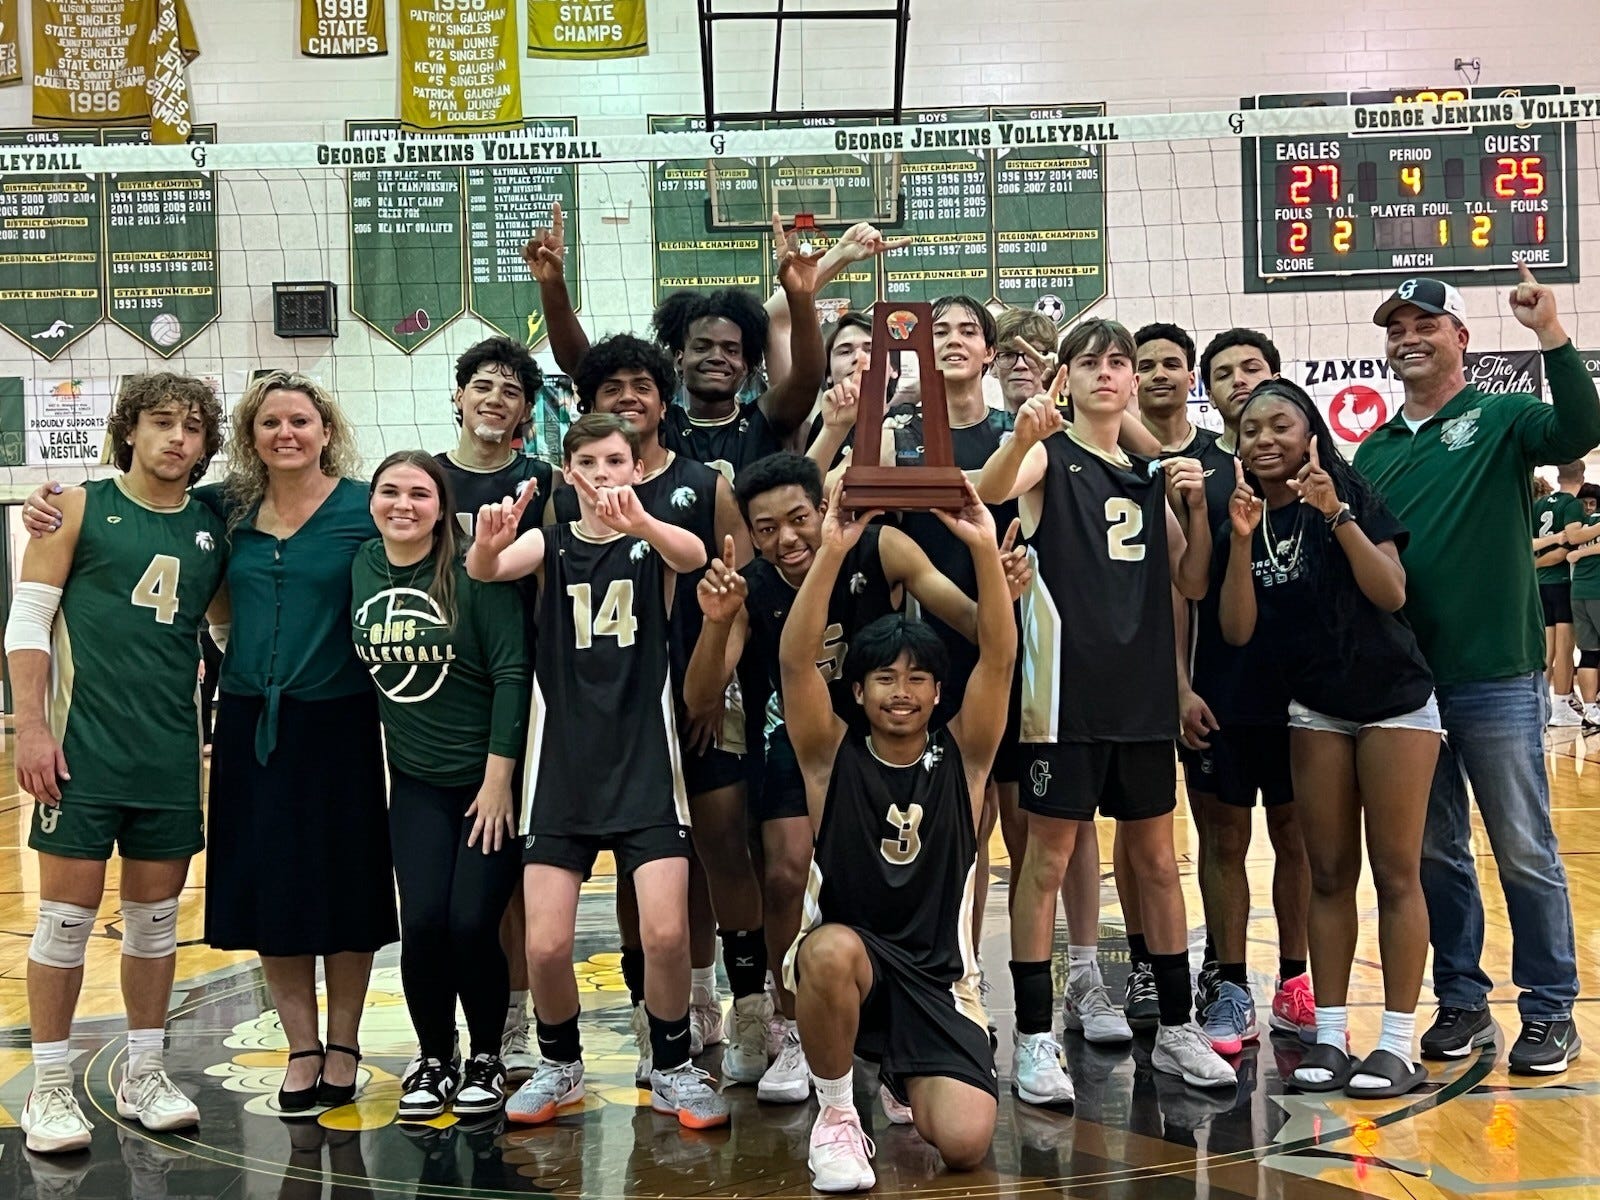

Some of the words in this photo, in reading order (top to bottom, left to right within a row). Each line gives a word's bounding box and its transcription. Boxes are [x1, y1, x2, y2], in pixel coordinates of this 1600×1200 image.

[59, 4, 86, 13] ALISON
[560, 4, 615, 22] STATE
[76, 14, 121, 26] SINGLES
[410, 9, 453, 23] PATRICK
[460, 8, 506, 23] GAUGHAN
[44, 24, 77, 37] STATE
[81, 24, 137, 38] RUNNER-UP
[318, 20, 367, 36] STATE
[429, 24, 441, 35] #1
[446, 23, 491, 36] SINGLES
[554, 25, 623, 42] CHAMPS
[57, 38, 92, 47] JENNIFER
[95, 37, 129, 47] SINCLAIR
[308, 37, 379, 54] CHAMPS
[427, 37, 454, 49] RYAN
[463, 36, 500, 49] DUNNE
[80, 47, 125, 59] SINGLES
[428, 50, 444, 60] #2
[449, 49, 494, 61] SINGLES
[58, 58, 90, 71] STATE
[414, 62, 446, 74] KEVIN
[458, 59, 506, 75] GAUGHAN
[34, 75, 80, 90] DOUBLES
[83, 80, 112, 91] STATE
[114, 75, 146, 88] CHAMP
[428, 75, 443, 86] #5
[449, 74, 495, 87] SINGLES
[413, 86, 455, 99] PATRICK
[463, 84, 511, 99] GAUGHAN
[69, 91, 120, 113] 1996
[428, 100, 457, 110] RYAN
[467, 98, 502, 110] DUNNE
[430, 111, 441, 121] #1
[447, 110, 496, 121] DOUBLES
[918, 113, 947, 123] BOYS
[1030, 110, 1062, 119] GIRLS
[1355, 107, 1424, 129] GEORGE
[1432, 104, 1513, 125] JENKINS
[26, 133, 59, 142] GIRLS
[835, 130, 903, 151] GEORGE
[911, 127, 991, 148] JENKINS
[998, 122, 1119, 145] VOLLEYBALL
[1276, 141, 1340, 161] EAGLES
[1484, 135, 1541, 154] GUEST
[317, 144, 386, 165] GEORGE
[394, 142, 475, 163] JENKINS
[482, 140, 602, 160] VOLLEYBALL
[1389, 148, 1431, 162] PERIOD
[930, 163, 974, 171] CHAMPIONS
[848, 177, 870, 187] 2001
[910, 175, 933, 185] 1995
[937, 174, 959, 184] 1996
[963, 172, 985, 183] 1997
[1023, 171, 1045, 181] 1997
[1400, 167, 1421, 195] 4
[1495, 157, 1544, 198] 25
[657, 181, 679, 191] 1997
[683, 180, 705, 190] 1998
[735, 180, 758, 190] 2000
[911, 187, 934, 197] 1999
[963, 184, 985, 194] 2001
[1023, 182, 1046, 193] 2007
[1049, 182, 1072, 192] 2011
[1290, 165, 1338, 204] 27
[21, 194, 44, 204] 2000
[47, 193, 69, 203] 2003
[110, 192, 133, 203] 1994
[136, 191, 159, 202] 1995
[162, 191, 185, 201] 1996
[911, 198, 934, 208] 2003
[963, 196, 986, 206] 2005
[21, 205, 45, 215] 2007
[163, 202, 186, 212] 2009
[188, 201, 211, 212] 2011
[1371, 204, 1415, 217] PLAYER
[1422, 203, 1452, 215] FOUL
[1464, 201, 1497, 215] T.O.L.
[1510, 199, 1549, 213] FOULS
[911, 210, 934, 220] 2010
[938, 208, 960, 219] 2012
[963, 207, 986, 217] 2017
[1275, 207, 1313, 220] FOULS
[111, 216, 134, 226] 2012
[22, 229, 45, 239] 2010
[1000, 232, 1043, 240] REGIONAL
[1333, 220, 1353, 252] 2
[1438, 219, 1448, 246] 1
[1471, 216, 1491, 248] 2
[1536, 215, 1545, 244] 1
[933, 234, 984, 242] CHAMPIONS
[1289, 222, 1308, 253] 2
[912, 246, 935, 256] 1995
[939, 245, 961, 255] 1997
[964, 244, 987, 254] 2005
[998, 243, 1020, 252] 2005
[1024, 242, 1047, 252] 2010
[45, 254, 94, 262] CHAMPIONS
[1392, 253, 1433, 267] MATCH
[1511, 249, 1550, 263] SCORE
[139, 262, 162, 272] 1995
[1276, 258, 1314, 271] SCORE
[890, 272, 922, 280] STATE
[924, 270, 984, 278] RUNNER-UP
[1001, 268, 1032, 276] STATE
[1036, 267, 1096, 275] RUNNER-UP
[888, 282, 910, 293] 2005
[1051, 277, 1073, 287] 2013
[2, 291, 33, 299] STATE
[36, 290, 95, 298] RUNNER-UP
[151, 287, 210, 295] RUNNER-UP
[114, 299, 137, 309] 1993
[141, 298, 163, 308] 1995
[1479, 355, 1514, 379] The
[31, 418, 64, 428] PROUDLY
[67, 418, 105, 427] SUPPORTS
[50, 431, 88, 445] EAGLES
[39, 445, 98, 459] WRESTLING
[1104, 497, 1146, 562] 2
[1539, 510, 1554, 538] 2
[131, 554, 180, 625] 4
[566, 579, 638, 649] 14
[370, 619, 416, 645] GJHS
[880, 803, 923, 865] 3
